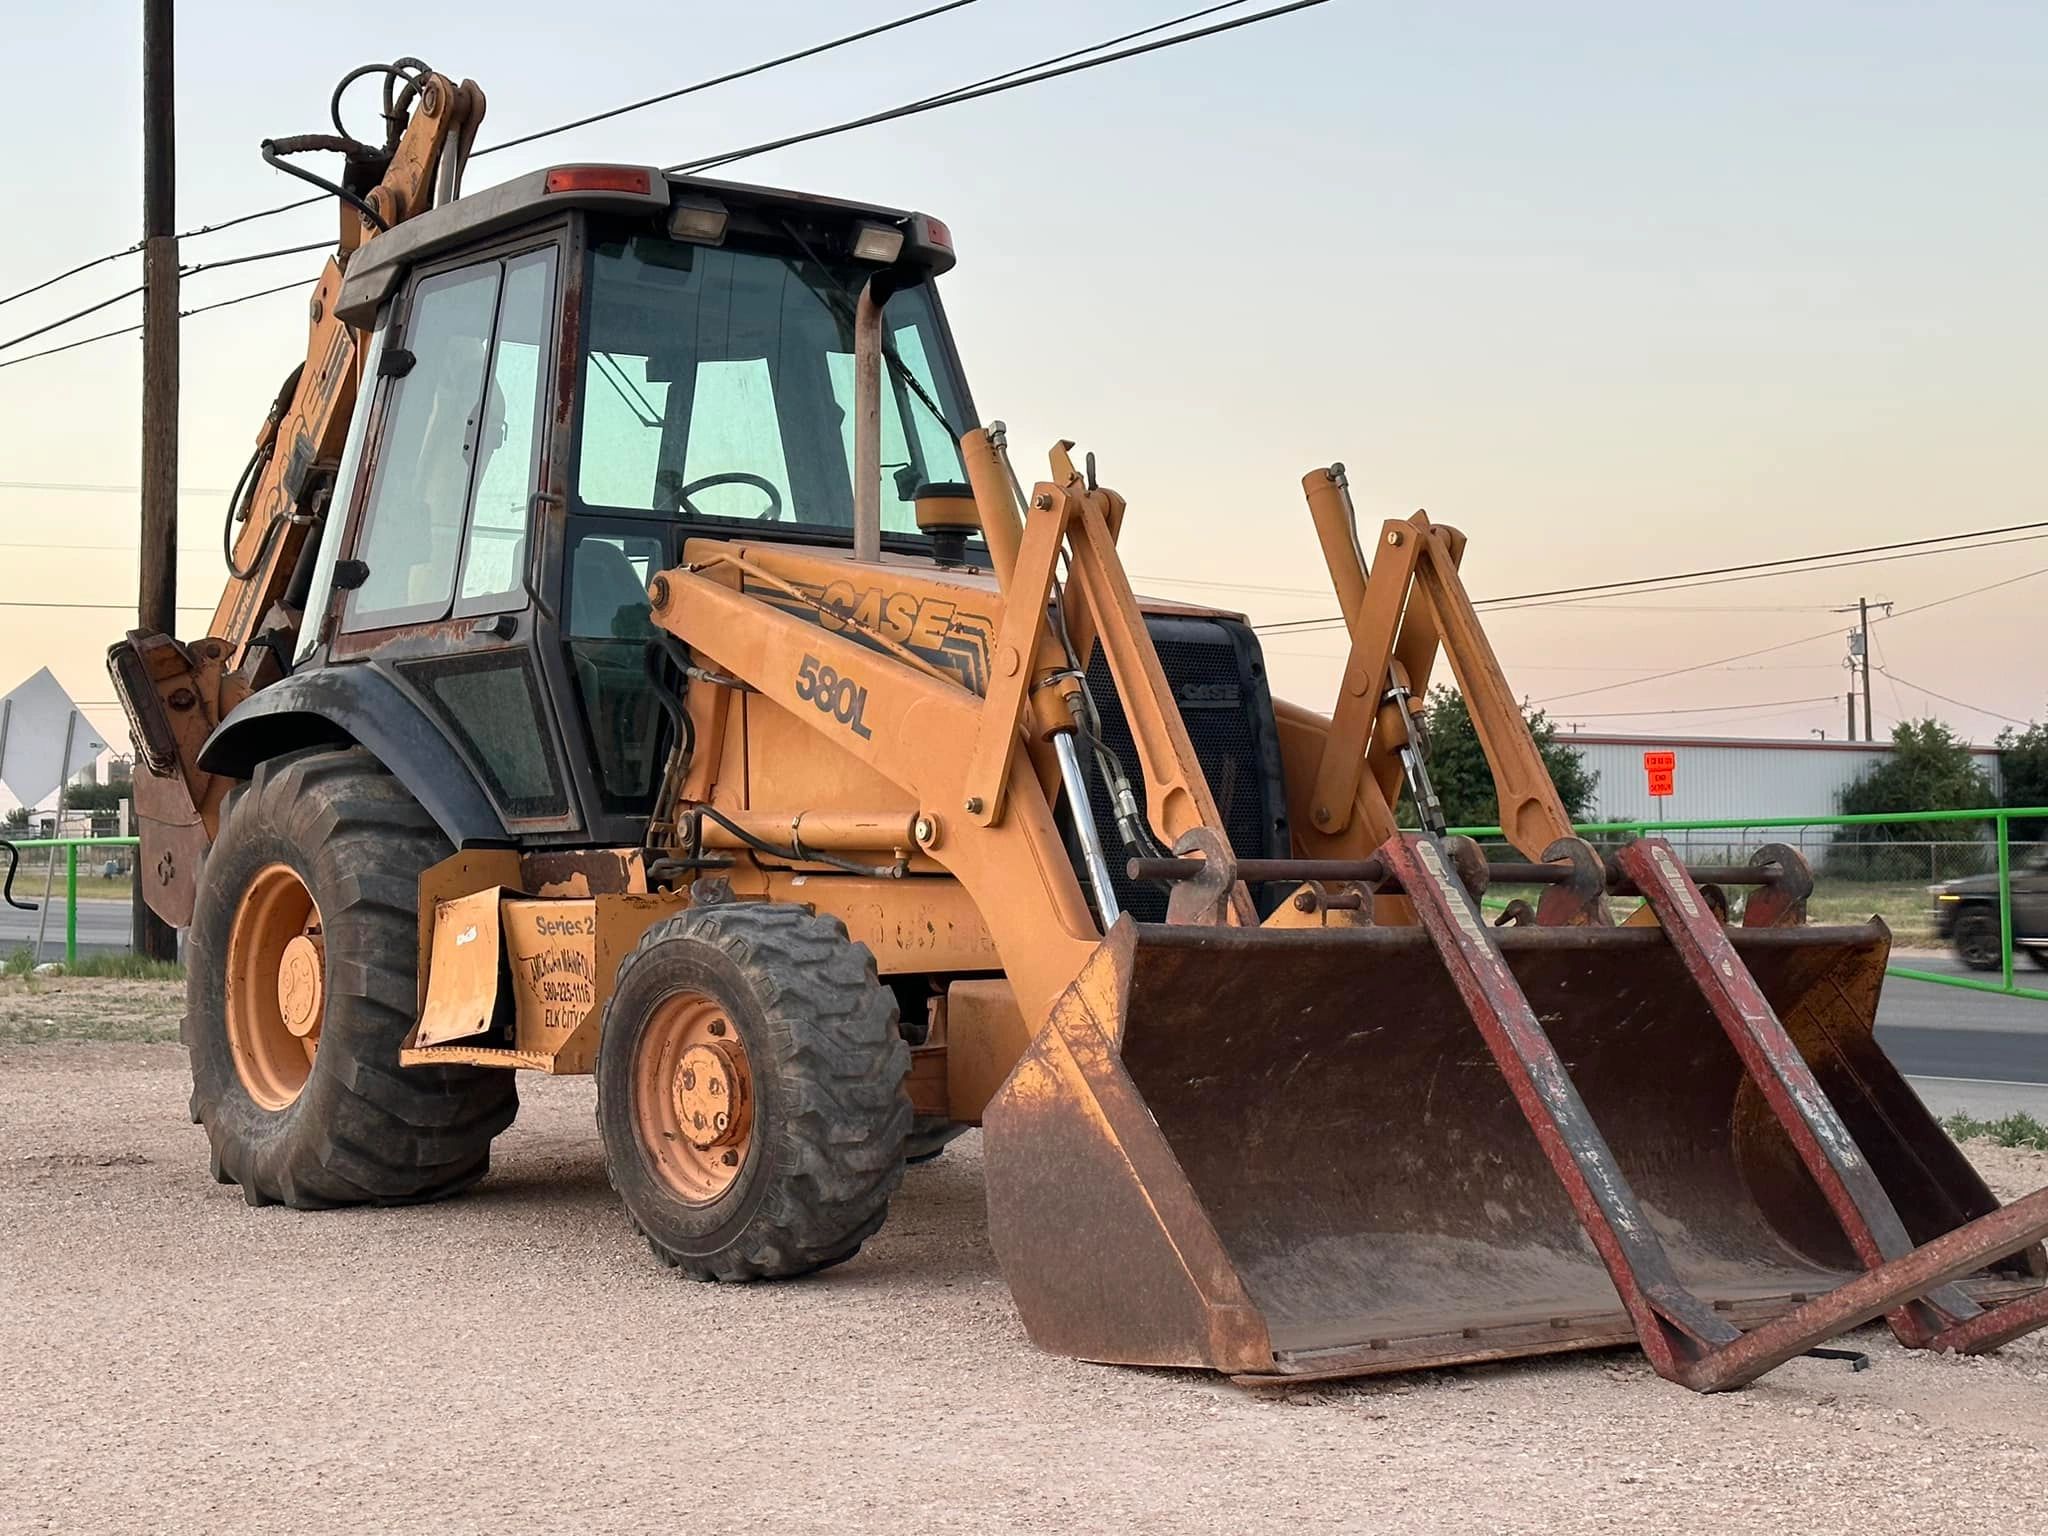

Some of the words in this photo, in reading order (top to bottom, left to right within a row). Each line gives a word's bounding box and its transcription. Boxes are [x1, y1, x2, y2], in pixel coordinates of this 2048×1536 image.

[818, 580, 956, 650] CASE
[795, 654, 872, 740] 580L
[1181, 684, 1239, 700] CASE
[535, 915, 584, 936] Series
[584, 917, 595, 935] 2
[545, 1009, 561, 1029] ELK
[562, 1009, 580, 1029] CITY
